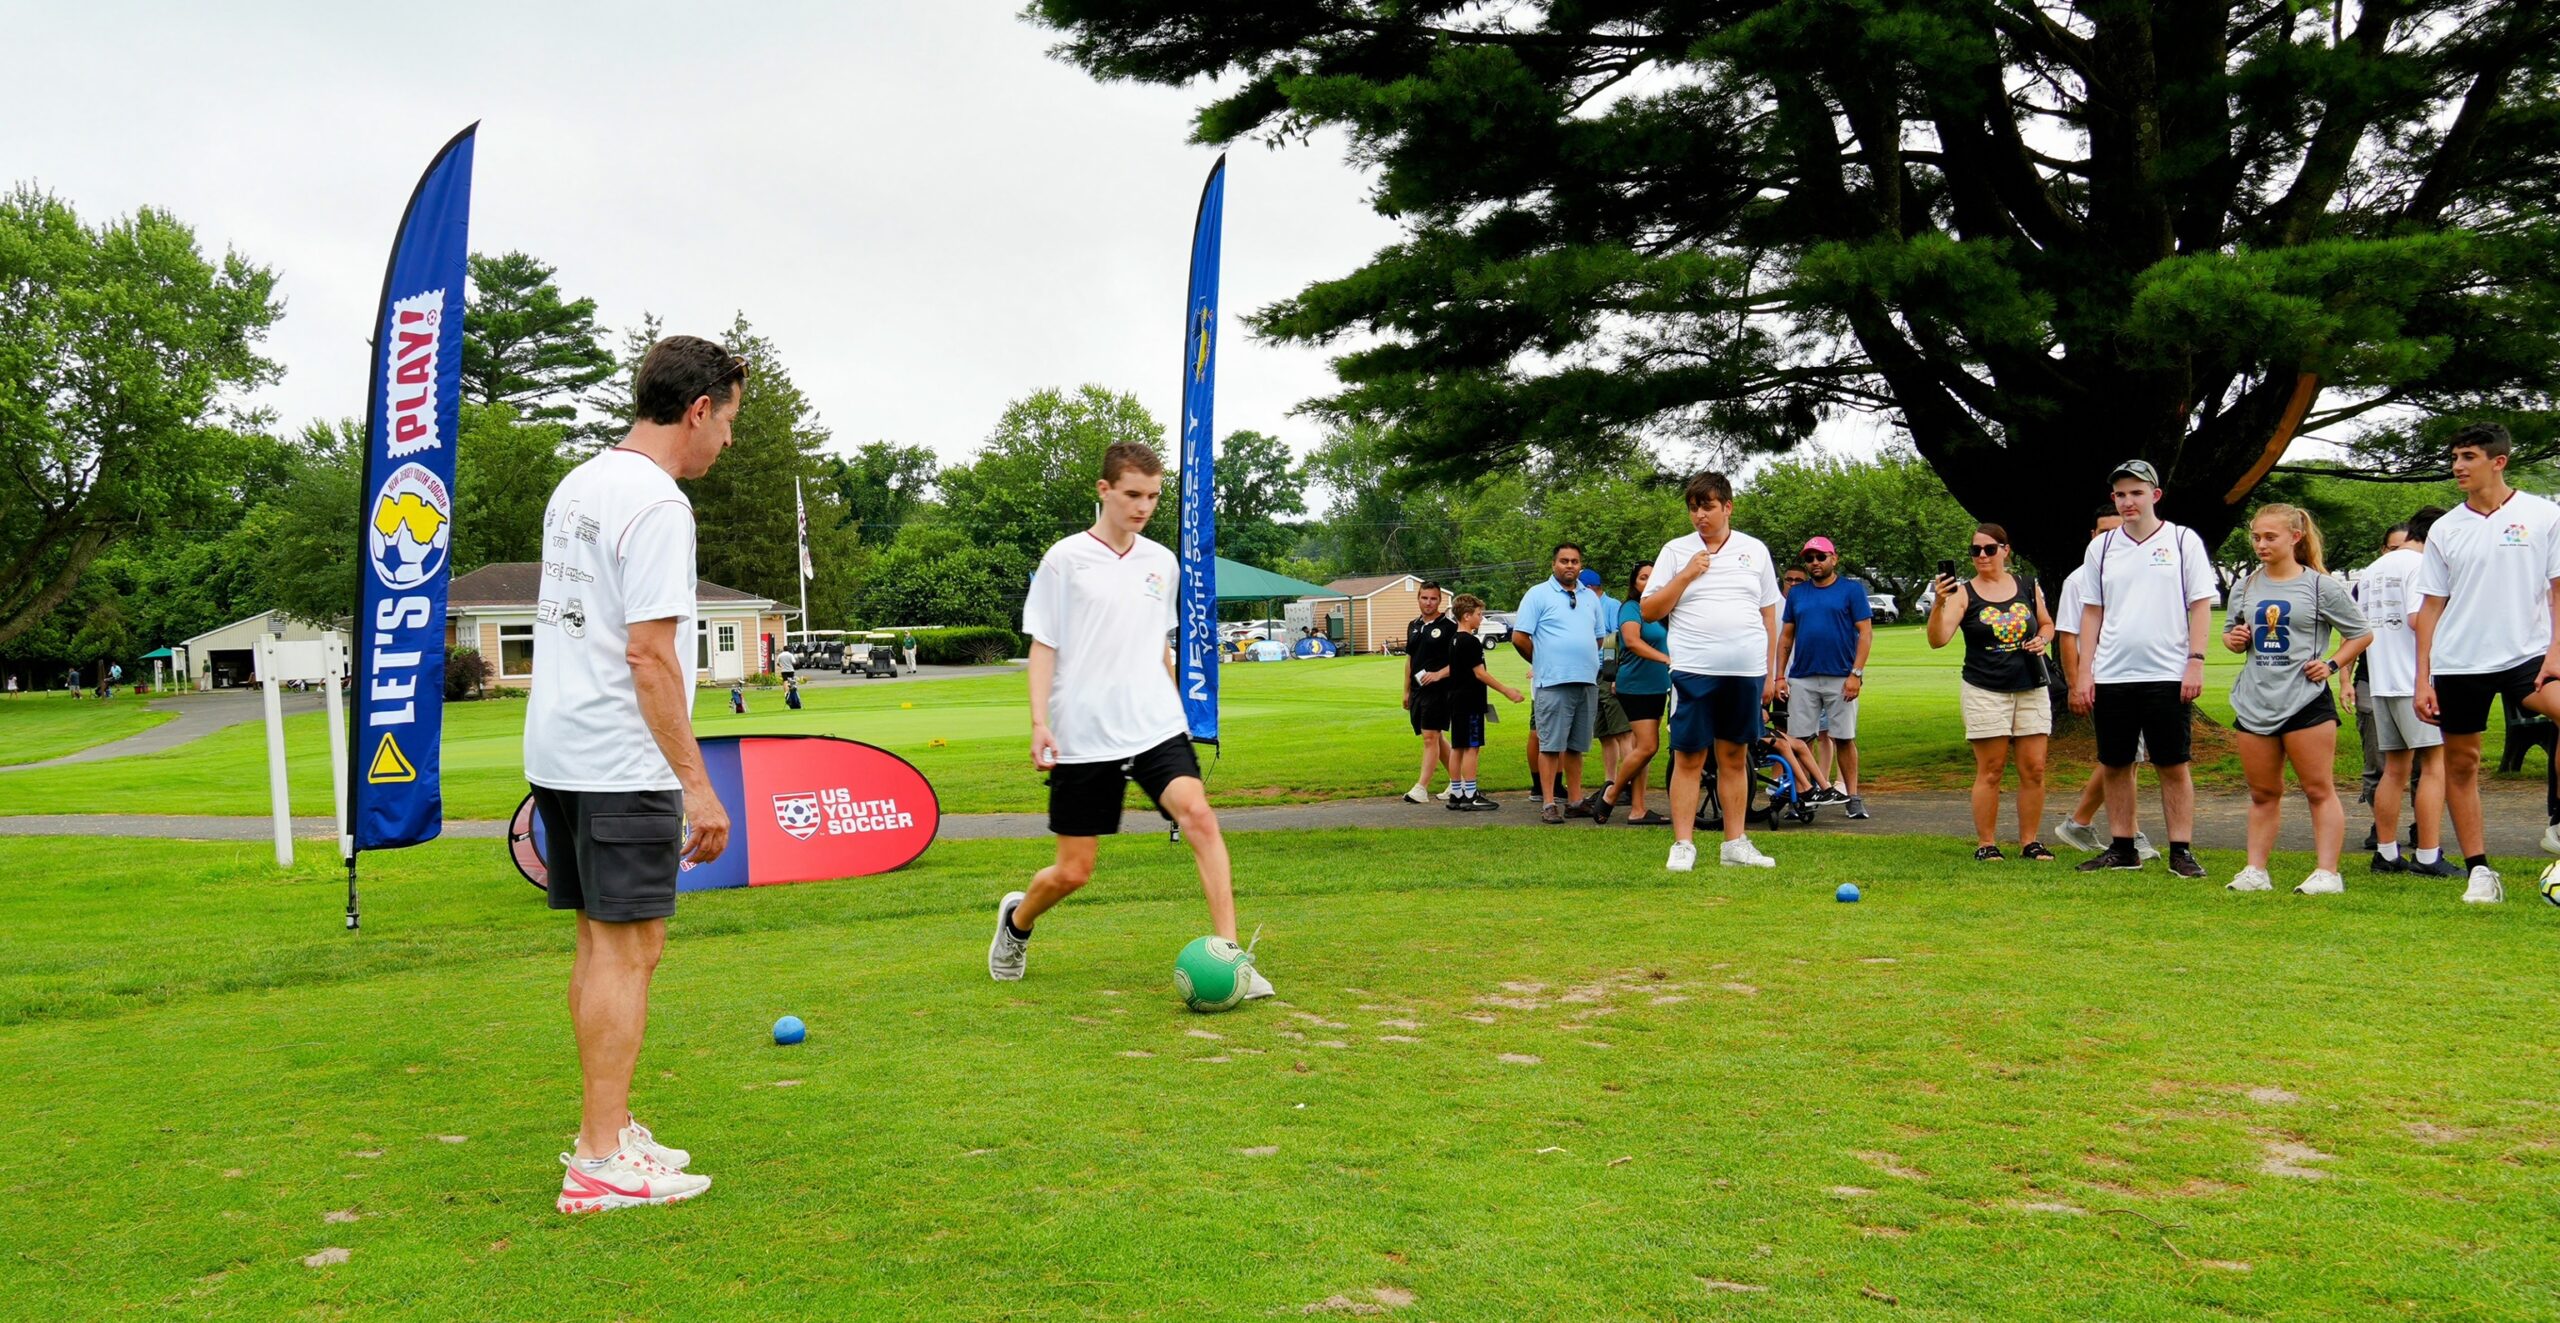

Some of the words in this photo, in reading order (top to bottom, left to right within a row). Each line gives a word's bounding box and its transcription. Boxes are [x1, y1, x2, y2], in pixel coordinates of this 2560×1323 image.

[395, 310, 433, 443] PLAY!
[388, 475, 400, 492] NEW
[400, 467, 413, 481] JERSEY
[414, 468, 430, 485] YOUTH
[428, 480, 447, 509] SOCCER
[1184, 408, 1199, 588] JERSEY
[1194, 571, 1213, 655] YOUTH
[369, 596, 431, 727] LET'S
[1186, 599, 1208, 701] NEW
[2263, 641, 2281, 649] FIFA
[820, 788, 851, 804] US
[823, 799, 897, 819] YOUTH
[827, 812, 914, 835] SOCCER
